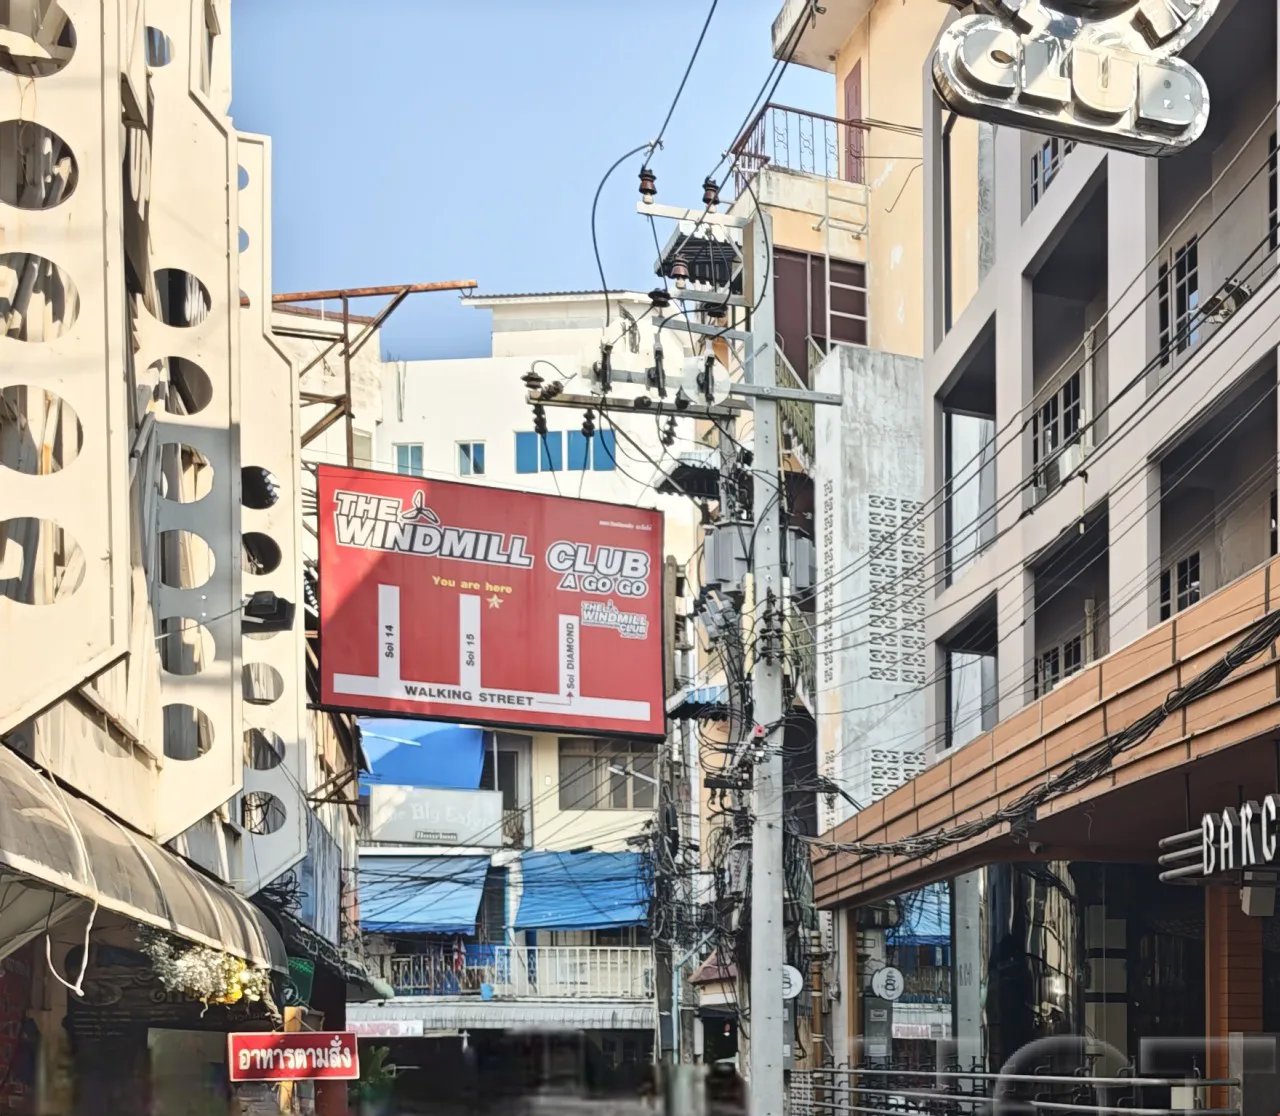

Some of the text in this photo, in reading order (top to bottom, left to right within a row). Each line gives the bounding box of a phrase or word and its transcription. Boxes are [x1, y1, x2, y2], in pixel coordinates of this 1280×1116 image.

[956, 26, 1202, 128] CLUB
[334, 489, 402, 522] THE
[334, 512, 650, 580] WINDMILL CLUB
[432, 576, 513, 594] You are here
[558, 573, 648, 598] A GO GO
[583, 610, 647, 626] WINDMILL
[385, 625, 394, 658] Soi 14
[466, 634, 475, 666] Soi 15
[566, 622, 575, 689] Soi DIAMOND
[404, 685, 534, 706] WALKING STREET
[239, 1035, 352, 1069] อาหารตามสั่ง
